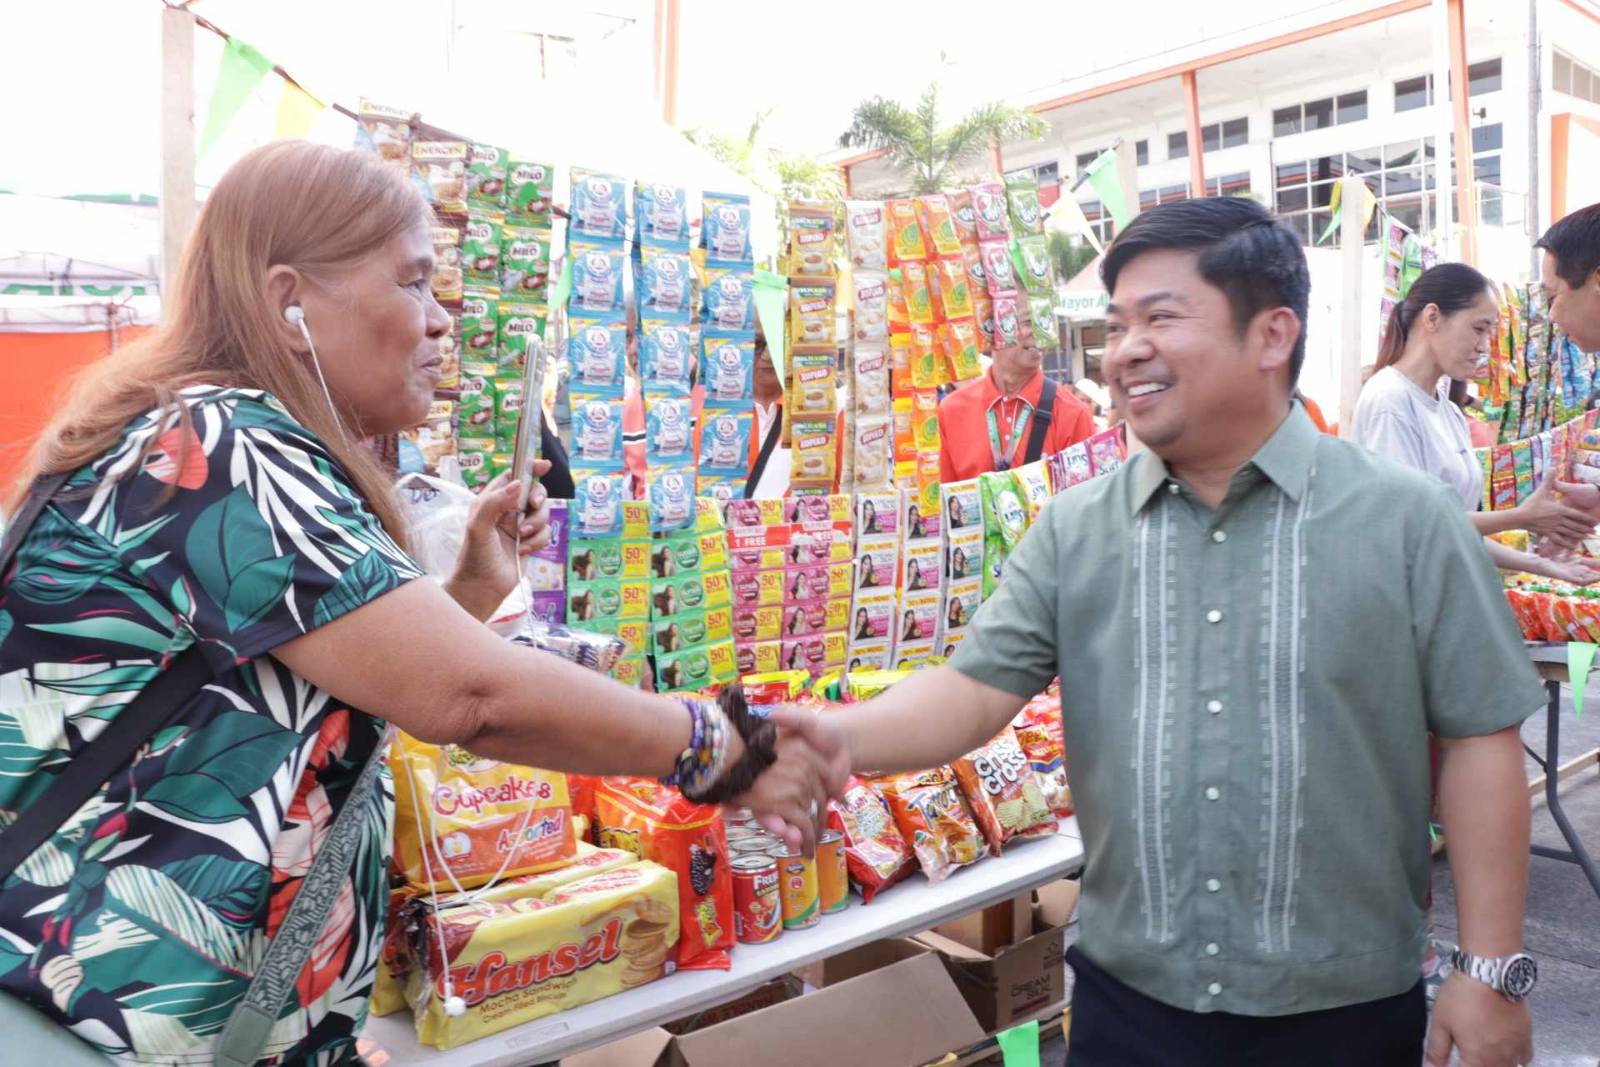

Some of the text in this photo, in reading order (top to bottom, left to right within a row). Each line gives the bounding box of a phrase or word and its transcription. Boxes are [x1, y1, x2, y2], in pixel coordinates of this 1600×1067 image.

[516, 170, 543, 181] MILO
[512, 245, 538, 257] MILO
[508, 322, 533, 333] MILO
[745, 536, 767, 547] FREE
[433, 776, 551, 815] Cupcakes
[436, 917, 622, 1007] Hansel
[480, 993, 520, 1016] Mocha
